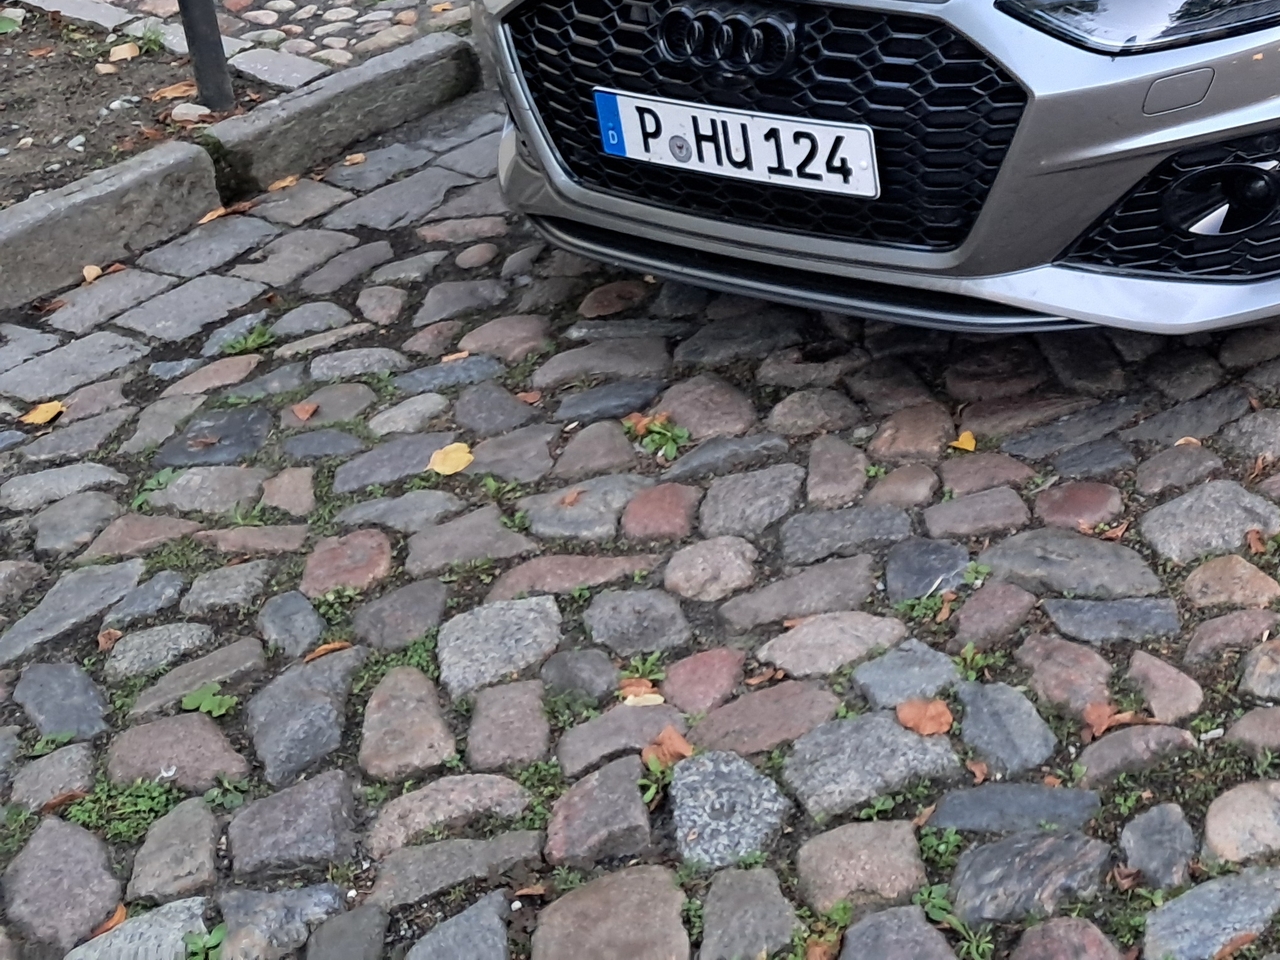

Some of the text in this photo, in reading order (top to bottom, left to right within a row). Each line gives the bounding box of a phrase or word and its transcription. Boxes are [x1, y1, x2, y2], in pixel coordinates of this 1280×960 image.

[609, 131, 619, 145] D
[635, 105, 853, 185] P HU 124
